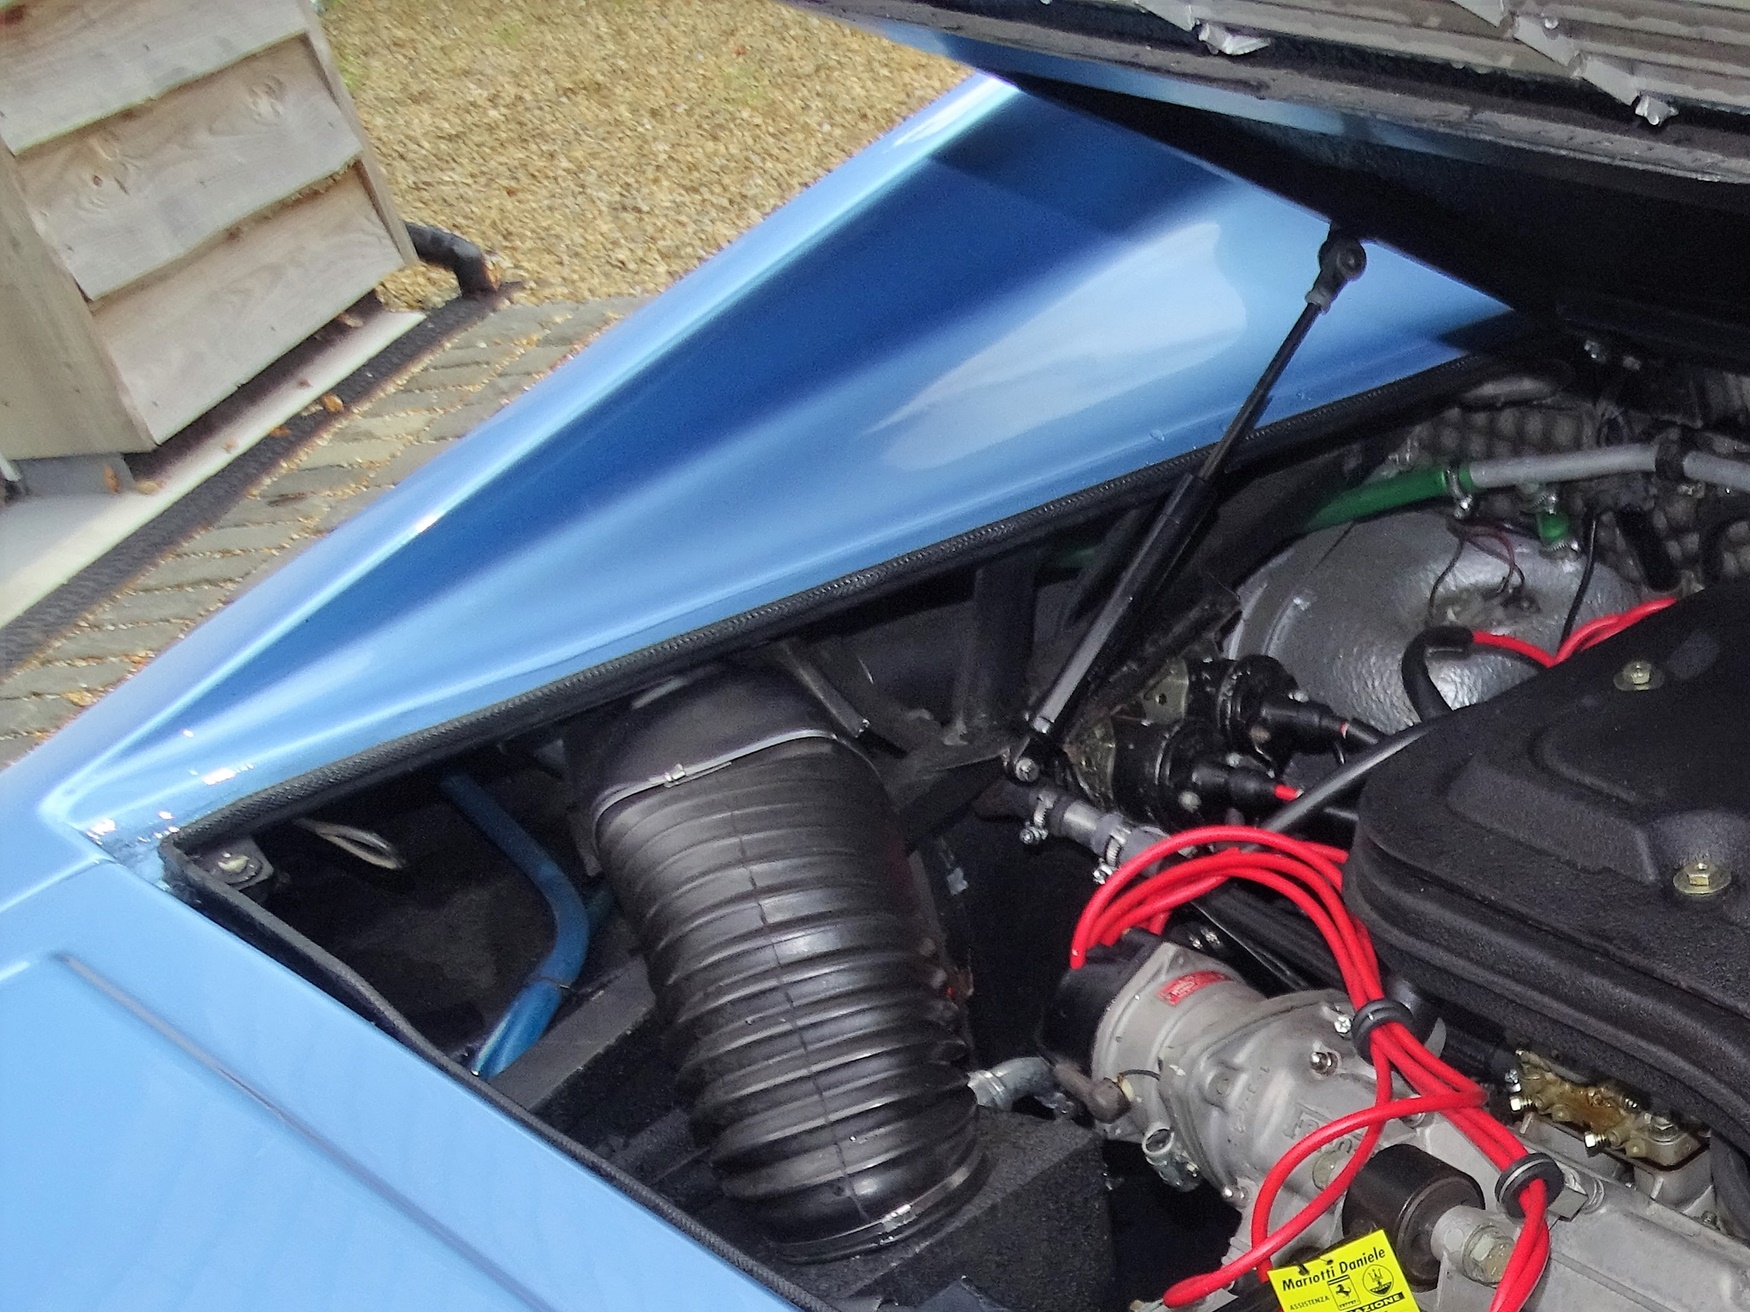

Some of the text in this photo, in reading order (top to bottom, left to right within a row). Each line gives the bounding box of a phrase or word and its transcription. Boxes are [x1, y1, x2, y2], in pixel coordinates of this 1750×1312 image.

[1282, 1247, 1386, 1292] Mariotti Daniele
[1290, 1295, 1330, 1311] ASSISTENZA
